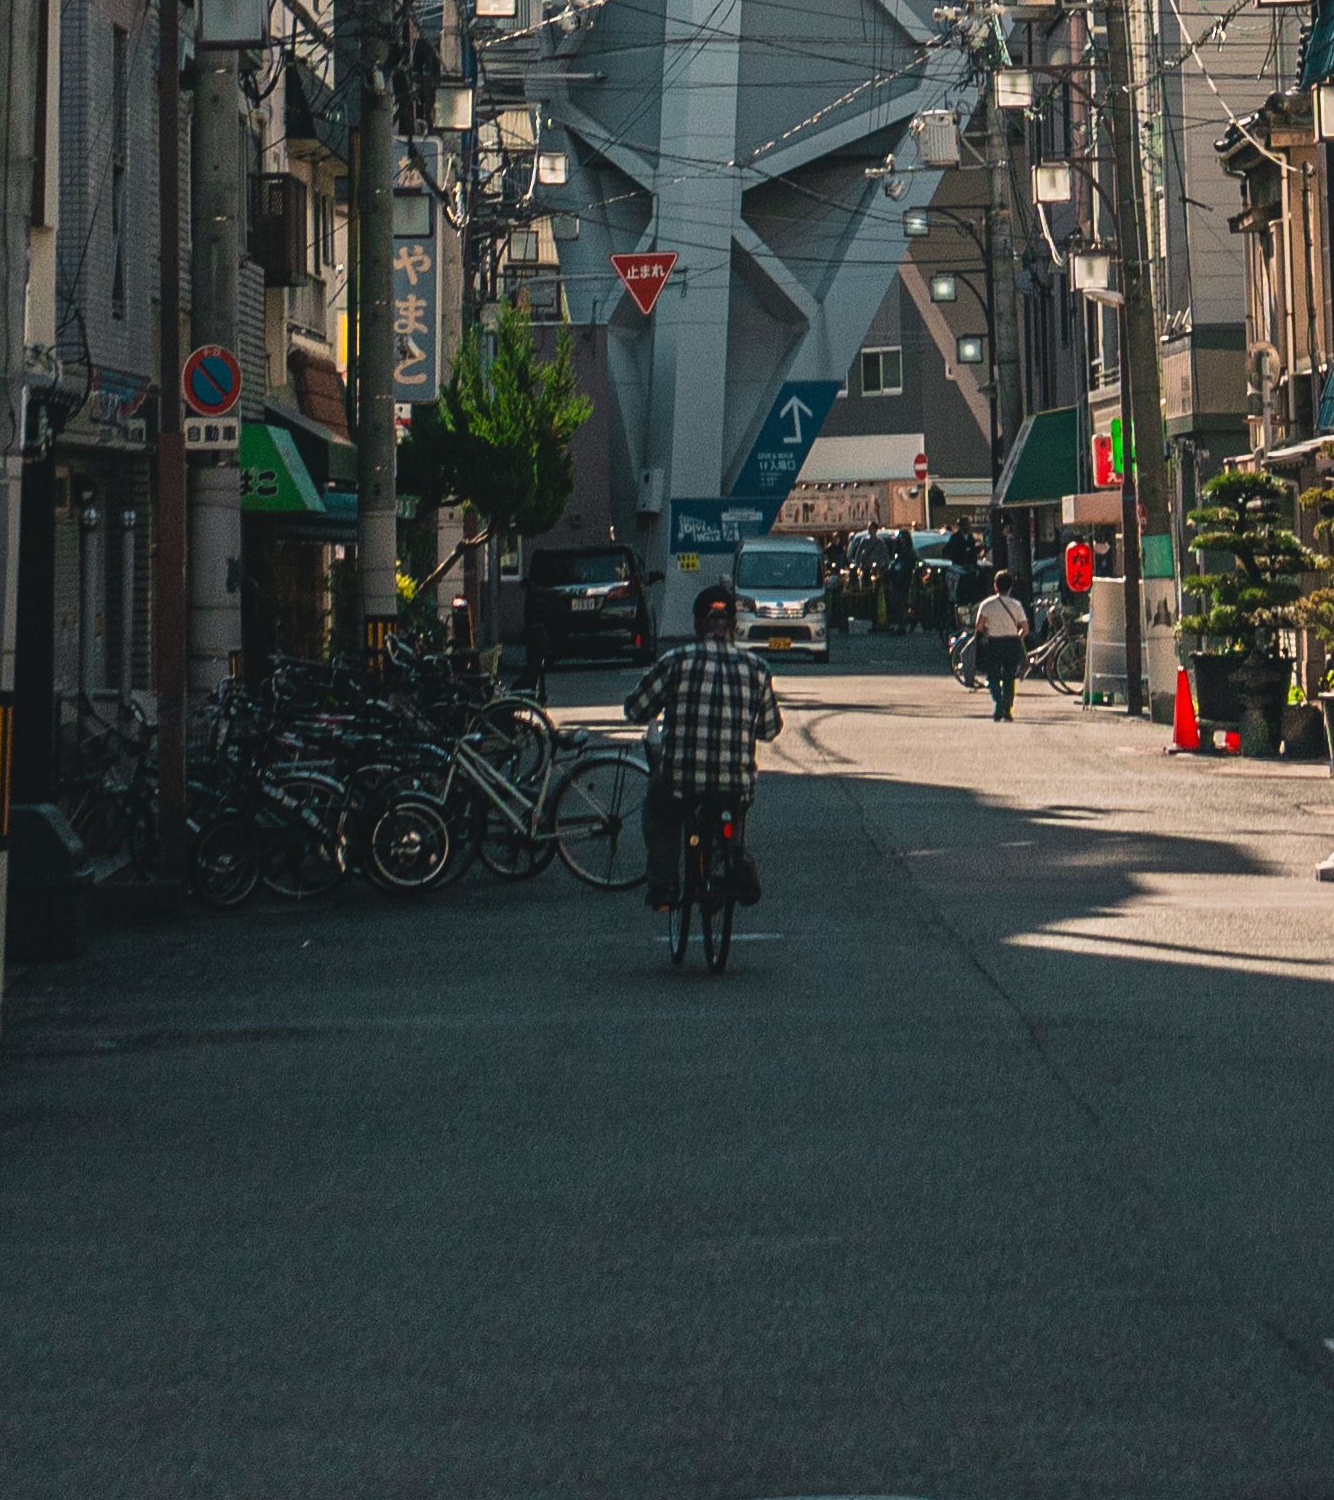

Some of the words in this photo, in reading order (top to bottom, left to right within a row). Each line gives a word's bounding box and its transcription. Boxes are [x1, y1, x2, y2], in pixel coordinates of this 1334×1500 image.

[626, 264, 666, 280] 止まれ
[393, 245, 432, 384] やまと
[187, 424, 237, 442] 自動車
